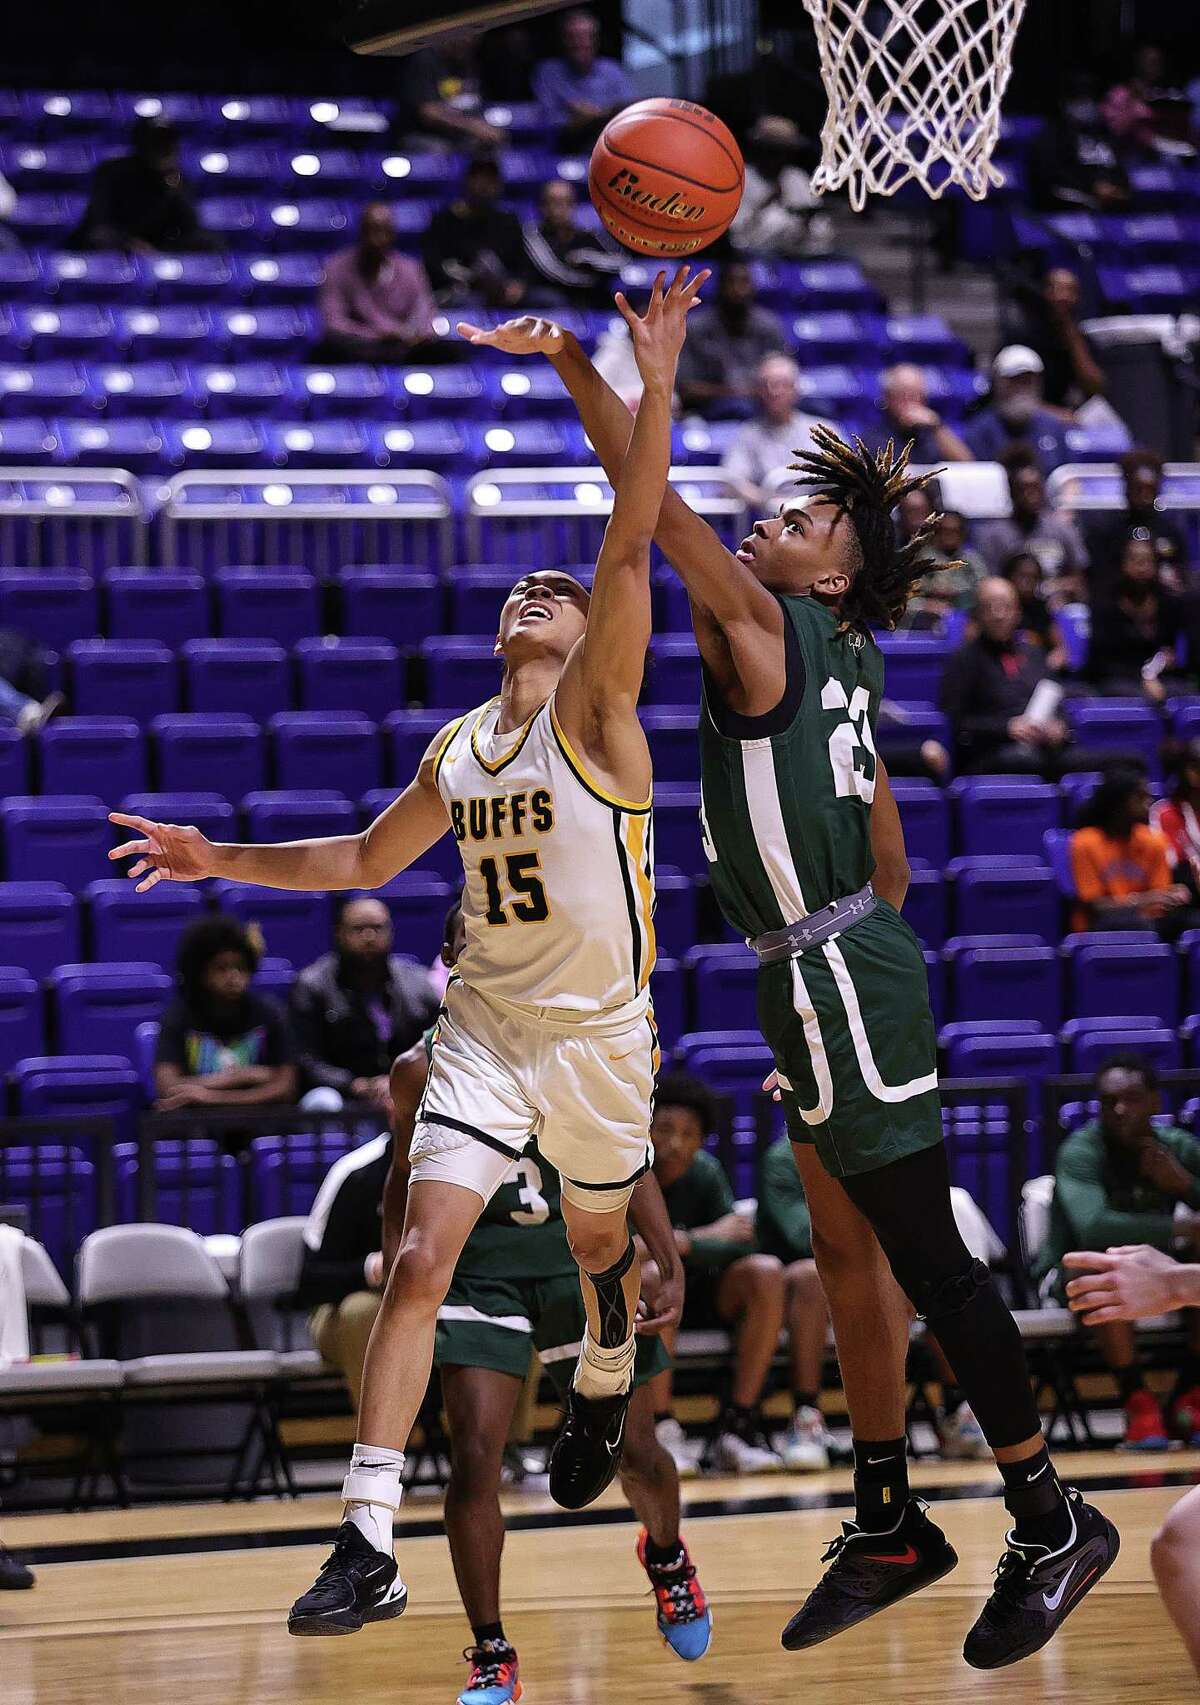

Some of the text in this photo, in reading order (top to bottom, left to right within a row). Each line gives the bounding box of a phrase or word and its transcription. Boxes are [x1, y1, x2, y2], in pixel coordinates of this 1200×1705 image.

[608, 168, 704, 221] Baden
[450, 788, 555, 842] BUFFS
[479, 849, 551, 927] 15
